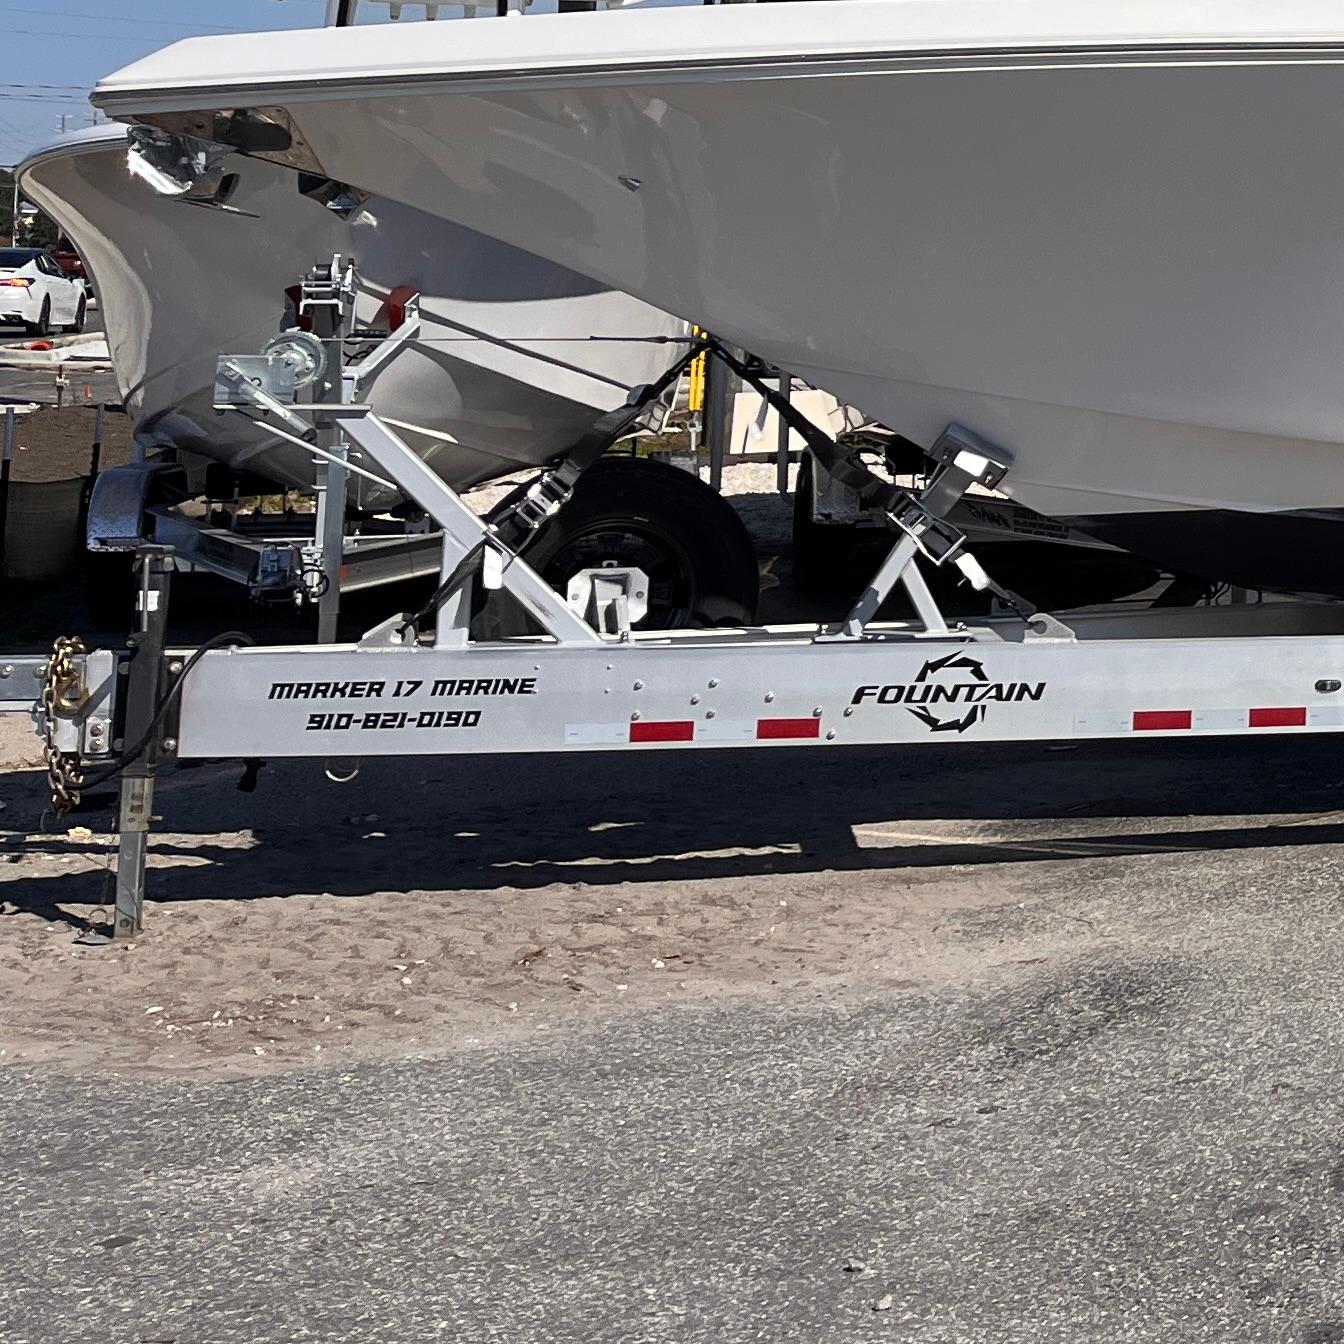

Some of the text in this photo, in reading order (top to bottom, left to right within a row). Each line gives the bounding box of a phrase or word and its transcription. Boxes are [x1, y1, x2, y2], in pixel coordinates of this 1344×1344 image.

[268, 678, 538, 700] MARKER 17 MARINE
[851, 681, 1047, 705] FOUNTAIN
[306, 710, 482, 731] 910-821-0190
